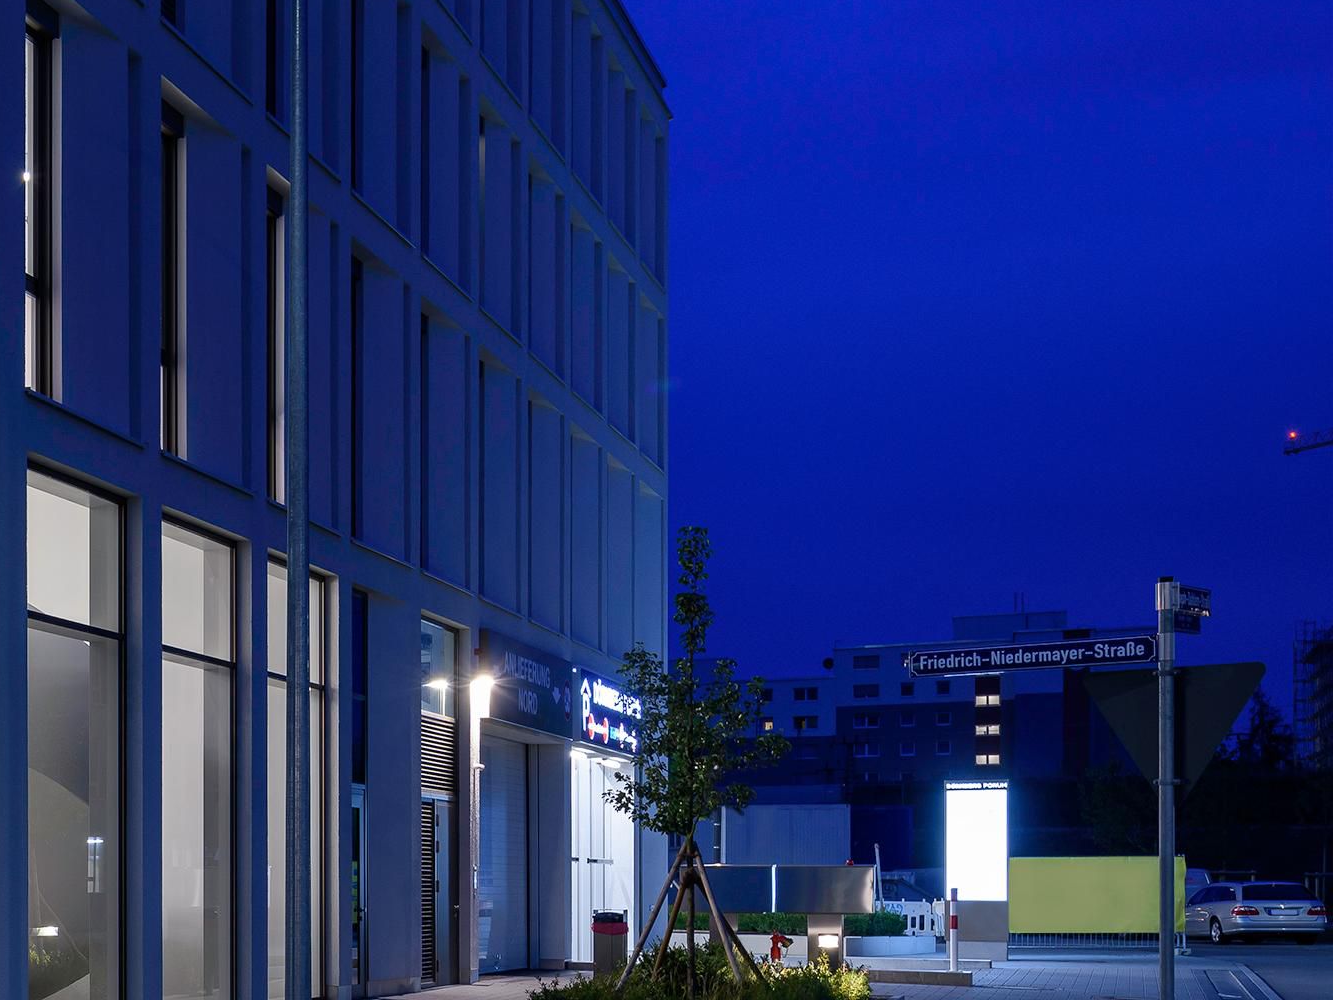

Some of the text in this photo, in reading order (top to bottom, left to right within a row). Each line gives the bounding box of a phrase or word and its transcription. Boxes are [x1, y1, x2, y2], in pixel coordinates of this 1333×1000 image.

[504, 651, 551, 689] ANLIEFERUNG
[920, 642, 1145, 670] Friedrich-Niedermayer-Straße
[518, 687, 538, 715] NORD
